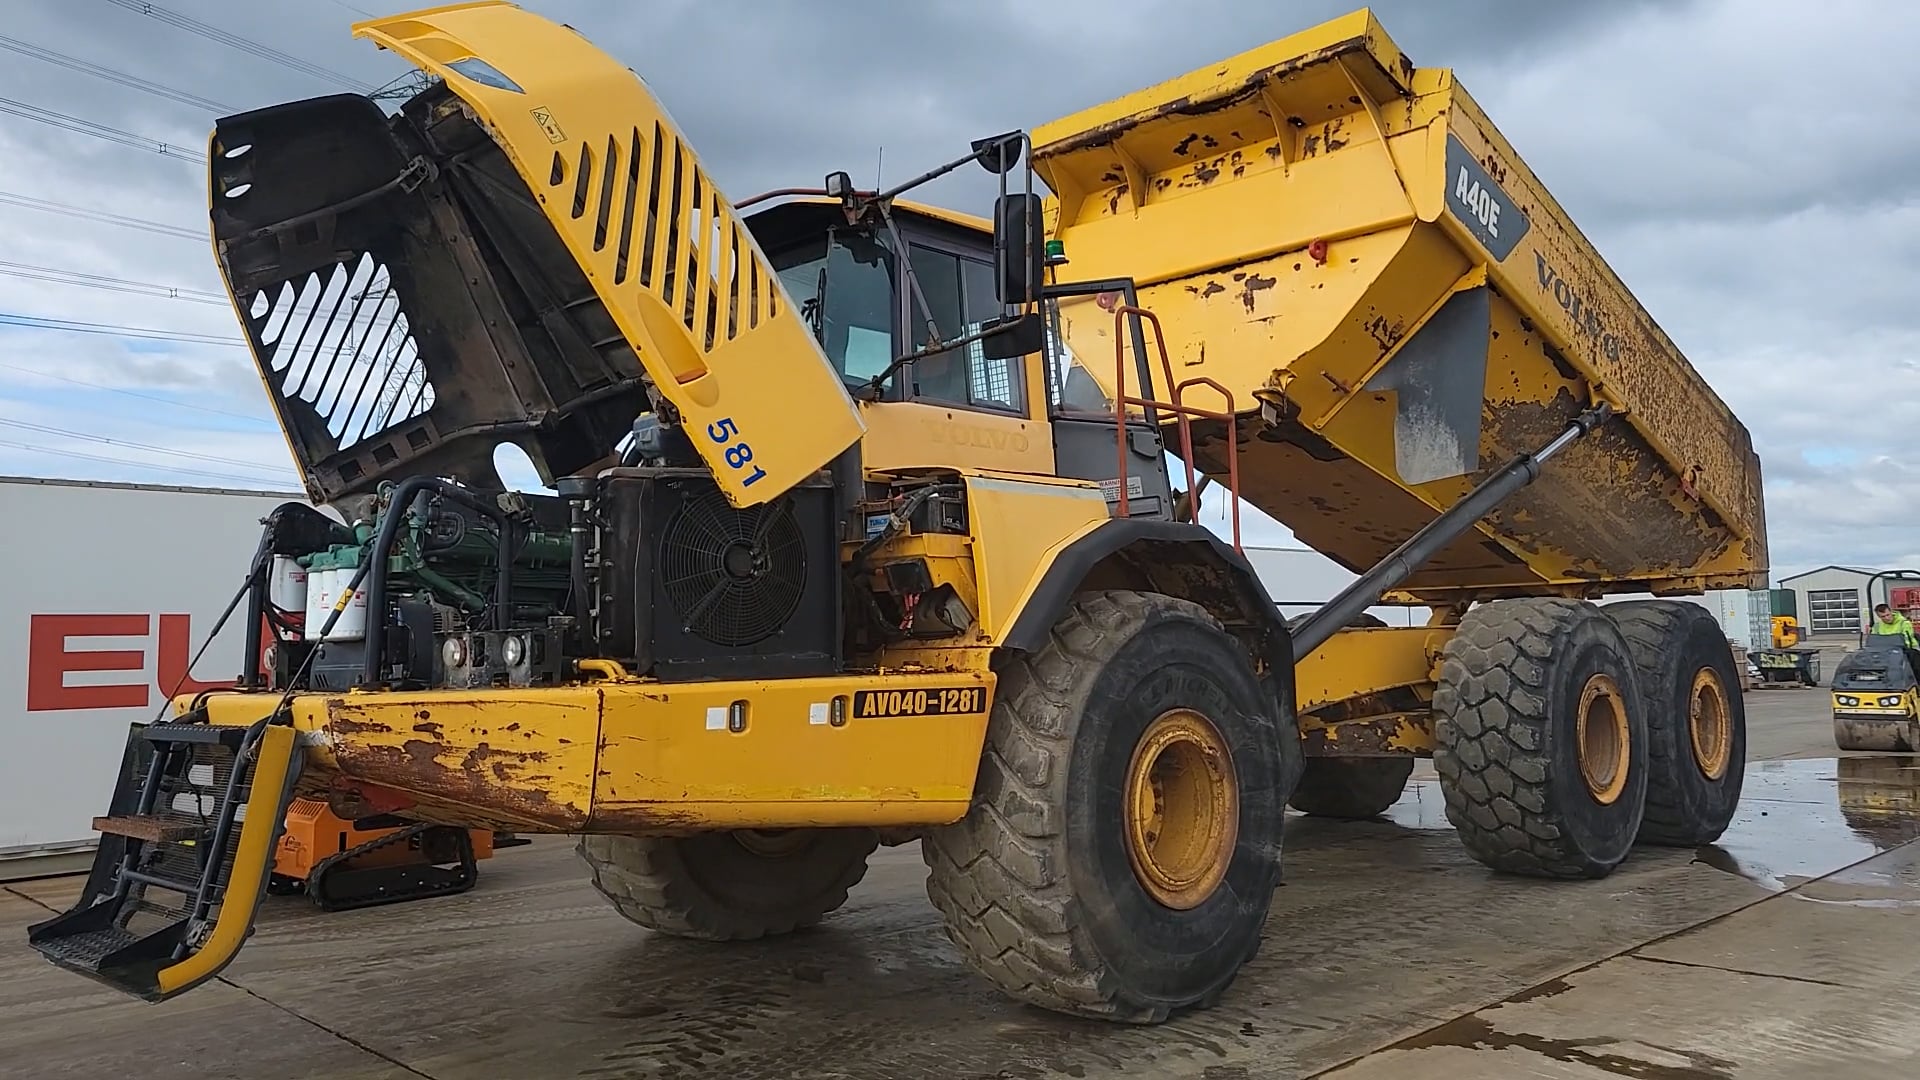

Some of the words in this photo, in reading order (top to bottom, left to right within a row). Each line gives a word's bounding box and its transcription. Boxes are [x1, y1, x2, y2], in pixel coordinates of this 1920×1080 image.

[1455, 165, 1501, 239] A40E
[706, 416, 767, 488] 581
[861, 688, 980, 717] AV040-1281
